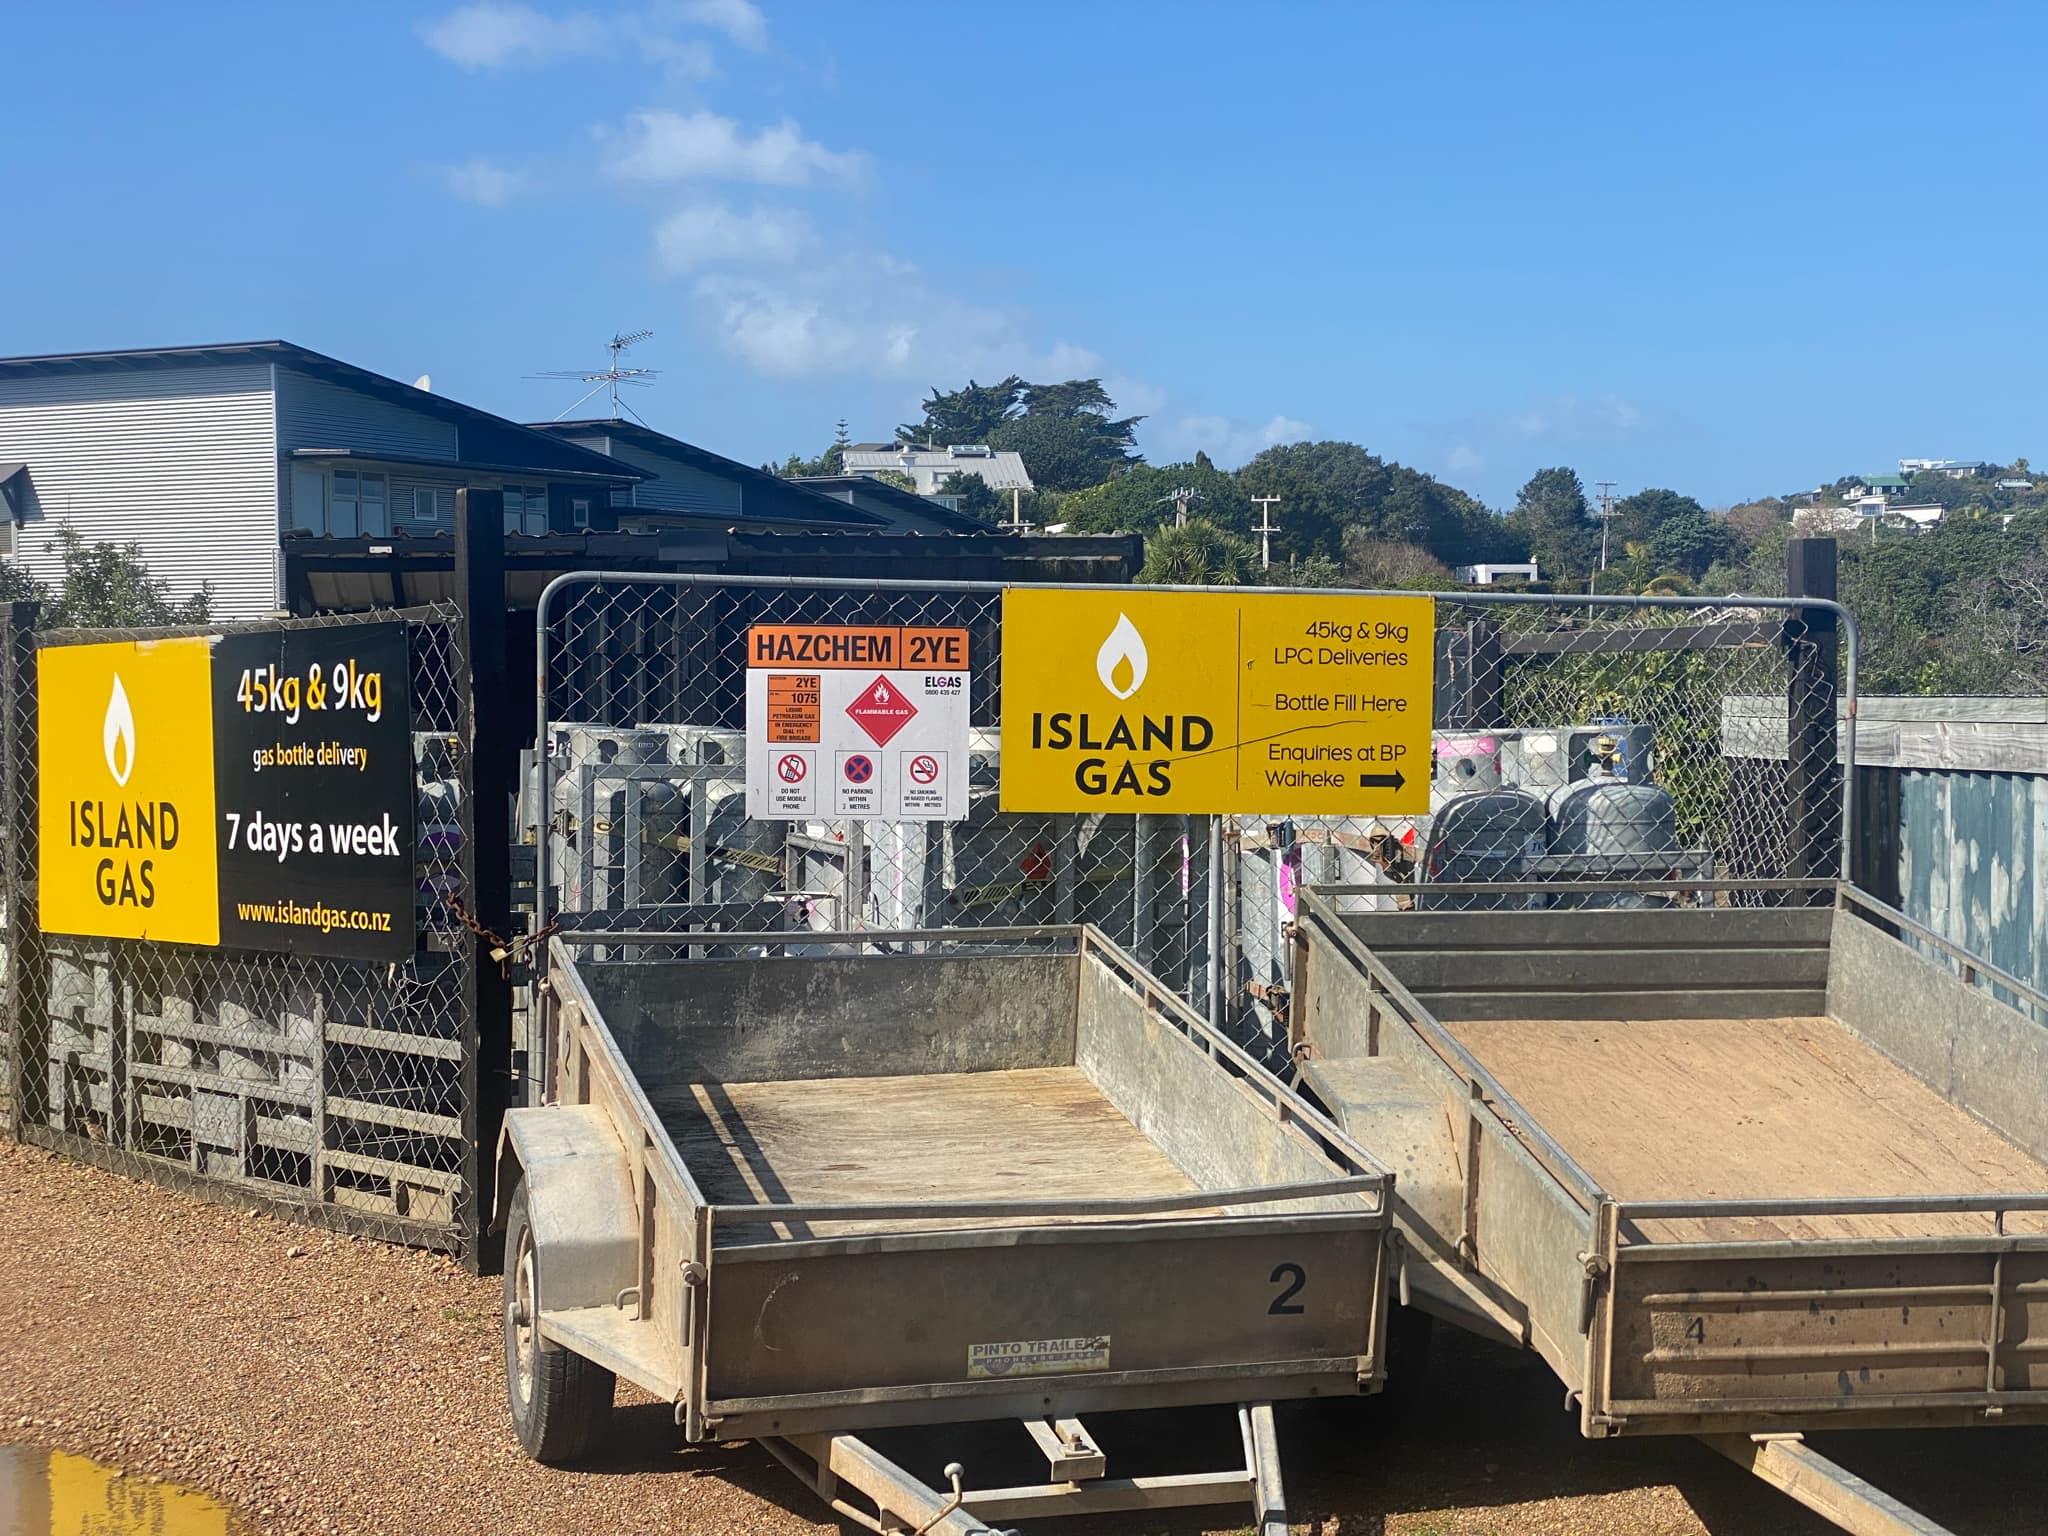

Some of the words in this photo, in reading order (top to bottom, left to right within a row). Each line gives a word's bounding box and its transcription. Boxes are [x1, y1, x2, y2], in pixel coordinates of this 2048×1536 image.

[1305, 622, 1352, 643] 45kg
[1357, 622, 1370, 639] &
[1375, 622, 1409, 644] 9kg
[757, 634, 892, 662] HAZCHEM
[910, 637, 961, 663] 2YE
[1274, 647, 1313, 665] LPG
[1319, 648, 1408, 666] Deliveries
[237, 663, 300, 726] 45kg
[306, 662, 327, 711] &
[332, 659, 382, 723] 9kg
[795, 677, 817, 688] 2YE
[925, 676, 962, 688] ELGAS
[791, 693, 818, 704] 1075
[1275, 694, 1329, 711] Bottle
[1334, 694, 1357, 711] Fill
[1362, 694, 1407, 712] Here
[1032, 712, 1214, 752] ISLAND
[252, 746, 275, 772] gas
[277, 741, 315, 767] bottle
[317, 743, 367, 771] delivery
[1269, 743, 1352, 764] Enquiries
[1357, 745, 1376, 761] at
[1380, 745, 1407, 761] BP
[1075, 759, 1172, 797] GAS
[1265, 770, 1345, 787] Waiheke
[70, 801, 179, 850] ISLAND
[226, 813, 241, 850] 7
[246, 811, 302, 863] days
[309, 823, 324, 854] a
[331, 813, 401, 857] week
[96, 858, 155, 909] GAS
[237, 901, 392, 934] www.islandgas.co.nz
[1267, 1263, 1307, 1316] 2
[1684, 1316, 1706, 1345] 4
[973, 1343, 1022, 1357] PINTO
[986, 1356, 1027, 1364] PHONE
